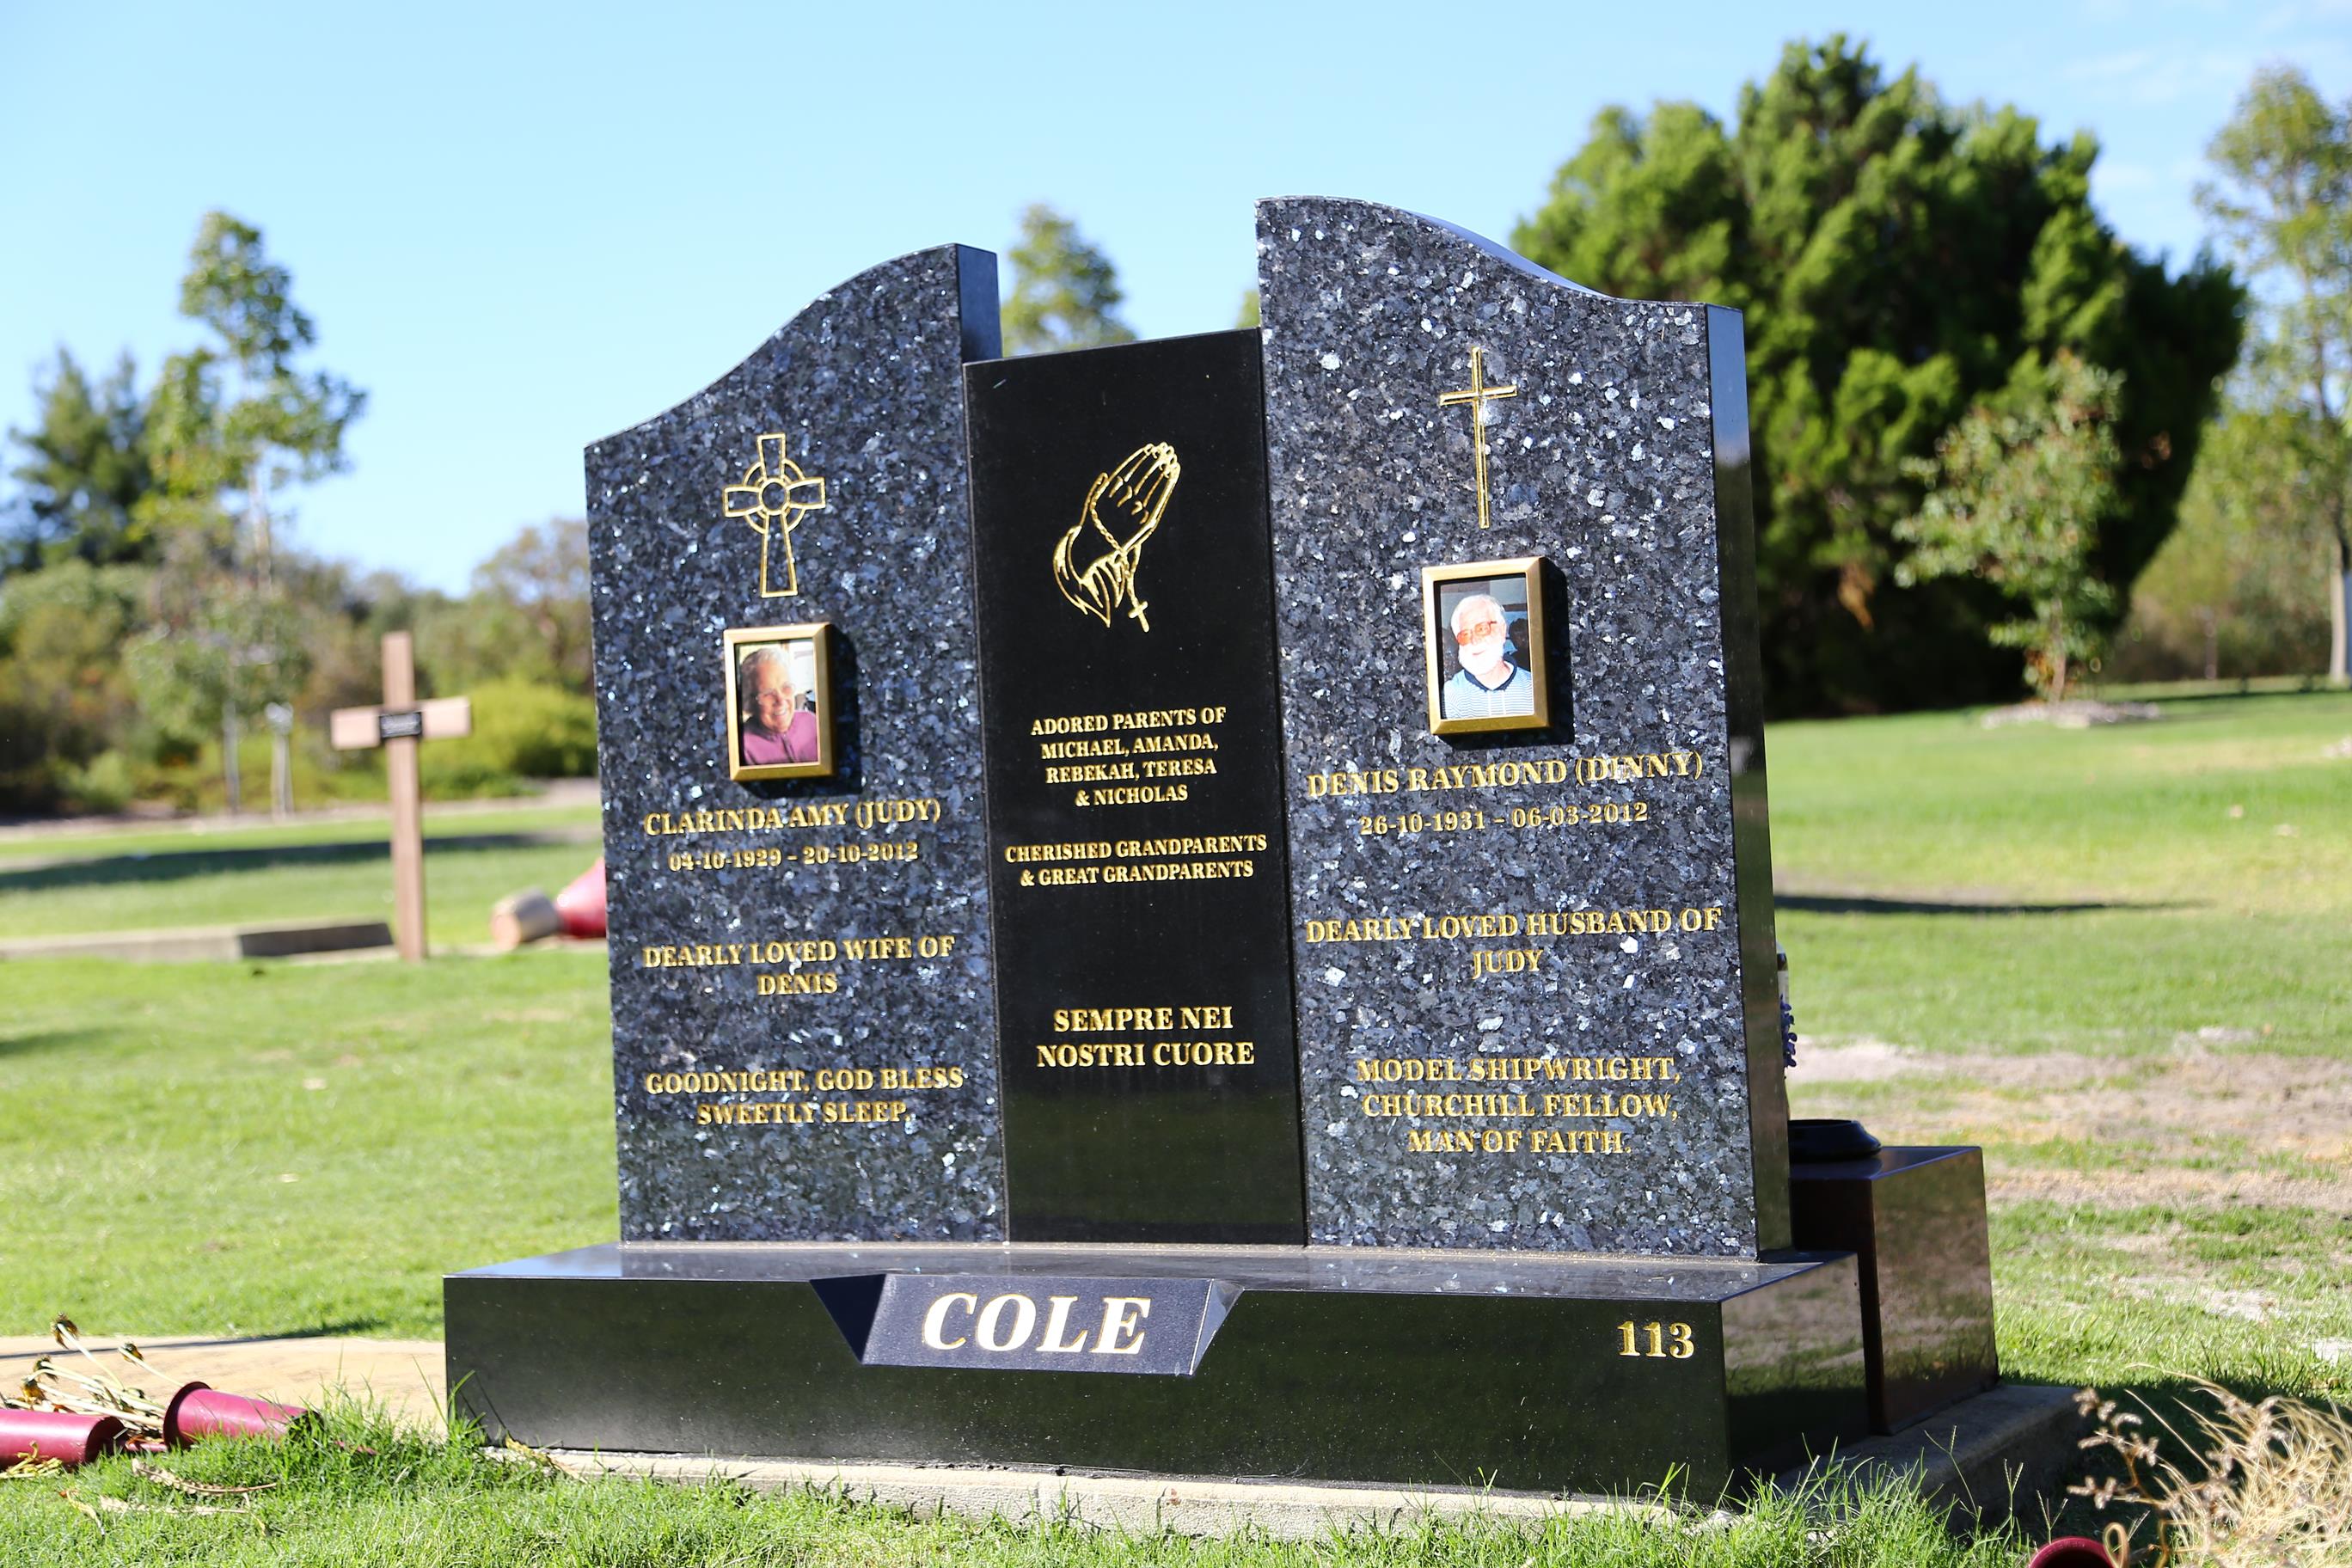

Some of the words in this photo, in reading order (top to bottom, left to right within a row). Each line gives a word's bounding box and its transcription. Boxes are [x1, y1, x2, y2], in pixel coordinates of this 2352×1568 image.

[1031, 715, 1108, 736] ADORED
[1112, 709, 1197, 730] PARENTS
[1200, 707, 1227, 725] OF
[1040, 738, 1130, 760] MICHAEL,
[1133, 733, 1219, 754] AMANDA,
[1045, 763, 1140, 784] REBEKAH,
[1142, 758, 1217, 777] TERESA
[1308, 769, 1399, 797] DENIS
[1408, 760, 1567, 791] RAYMOND
[1575, 751, 1703, 786] (DINNY)
[1075, 790, 1091, 806] &
[1093, 785, 1188, 805] NICHOLAS
[646, 807, 783, 836] CLARINDA
[788, 803, 849, 827] AMY
[855, 798, 940, 830] (JUDY)
[1359, 811, 1485, 836] 26-10-1931
[1511, 802, 1648, 829] 06-03-2012
[668, 848, 781, 871] 04-10-1929
[802, 841, 918, 865] 20-10-2012
[1004, 842, 1111, 863] CHERISHED
[1116, 834, 1267, 858] GRANDPARENTS
[1020, 870, 1036, 887] &
[1039, 867, 1099, 886] GREAT
[1103, 861, 1253, 884] GRANDPARENTS
[1305, 917, 1417, 943] DEARLY
[1423, 914, 1519, 940] LOVED
[1526, 910, 1671, 936] HUSBAND
[1680, 907, 1722, 932] OF
[642, 943, 742, 968] DEARLY
[750, 940, 836, 964] LOVED
[843, 937, 911, 961] WIFE
[917, 935, 955, 957] OF
[1471, 949, 1543, 979] JUDY
[757, 974, 838, 995] DENIS
[1053, 1008, 1173, 1032] SEMPRE
[1179, 1006, 1234, 1029] NEI
[1036, 1043, 1146, 1068] NOSTRI
[1153, 1041, 1255, 1065] CUORE
[646, 1070, 810, 1094] GOODNIGHT,
[817, 1069, 874, 1092] GOD
[880, 1066, 964, 1090] BLESS
[1356, 1057, 1462, 1082] MODEL
[1470, 1057, 1681, 1084] SHIPWRIGHT,
[697, 1102, 815, 1125] SWEETLY
[1362, 1093, 1535, 1118] CHURCHILL
[1542, 1092, 1678, 1122] FELLOW,
[1408, 1130, 1473, 1153] MAN
[1481, 1129, 1522, 1153] OF
[1529, 1129, 1632, 1154] FAITH.
[921, 1291, 1151, 1356] COLE
[1615, 1320, 1694, 1360] 113
